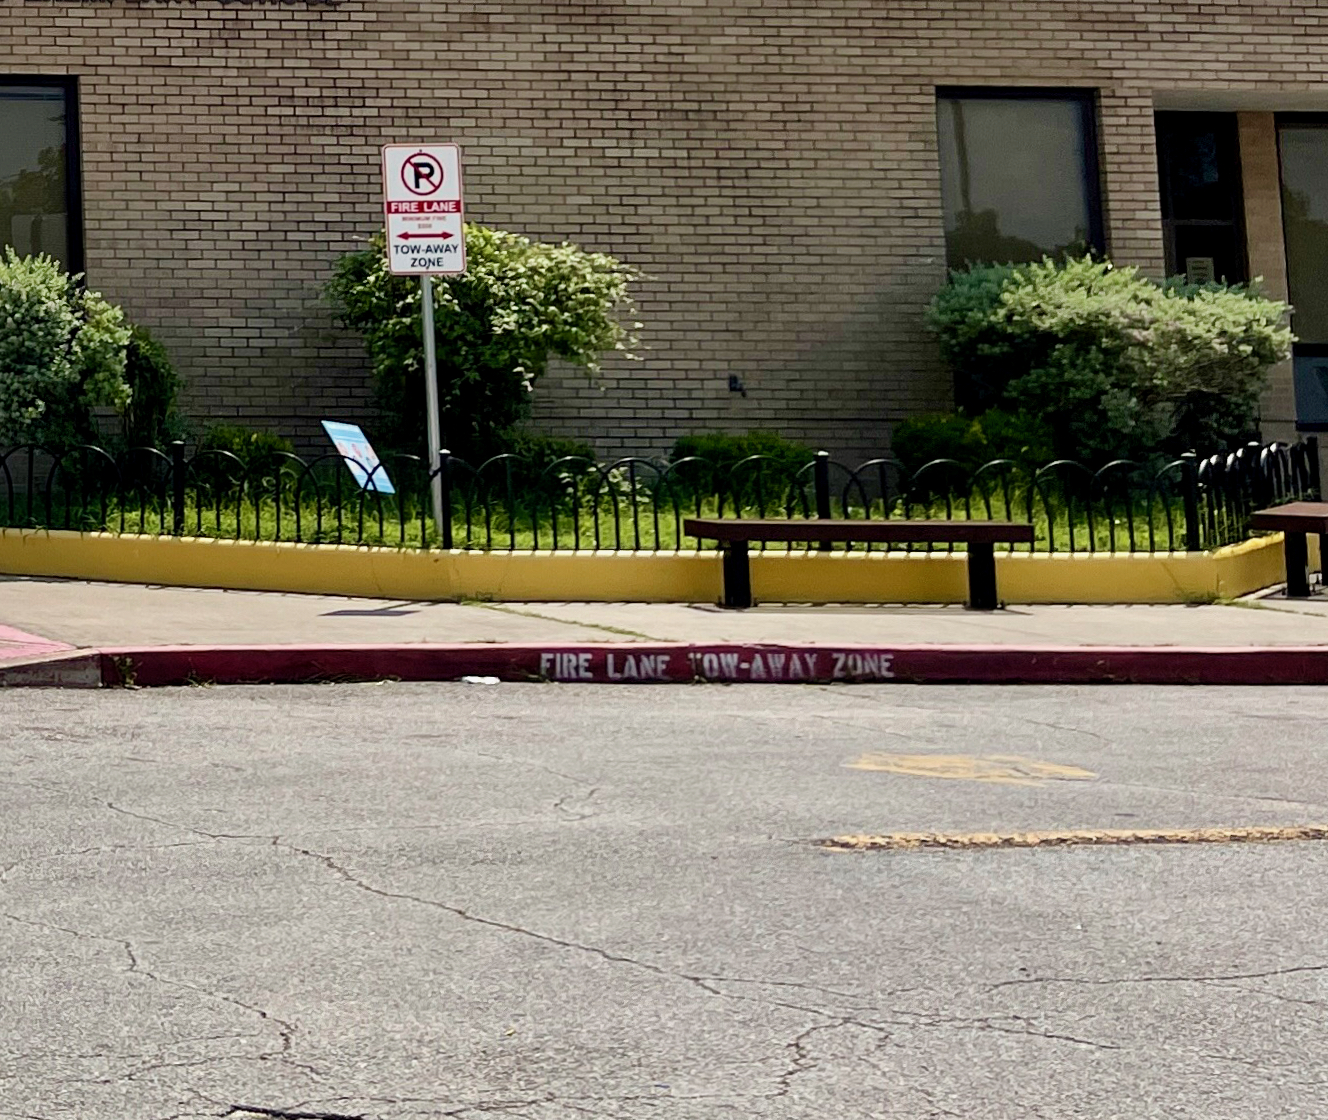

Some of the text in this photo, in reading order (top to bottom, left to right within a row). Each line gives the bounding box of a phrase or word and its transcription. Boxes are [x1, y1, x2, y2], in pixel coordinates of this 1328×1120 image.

[391, 201, 457, 213] FIRE LANE
[393, 244, 459, 255] TOW-AWAY
[410, 257, 444, 268] ZONE
[540, 653, 593, 678] FIRE
[687, 653, 818, 679] TOW-AWAY
[831, 654, 895, 678] ZONE
